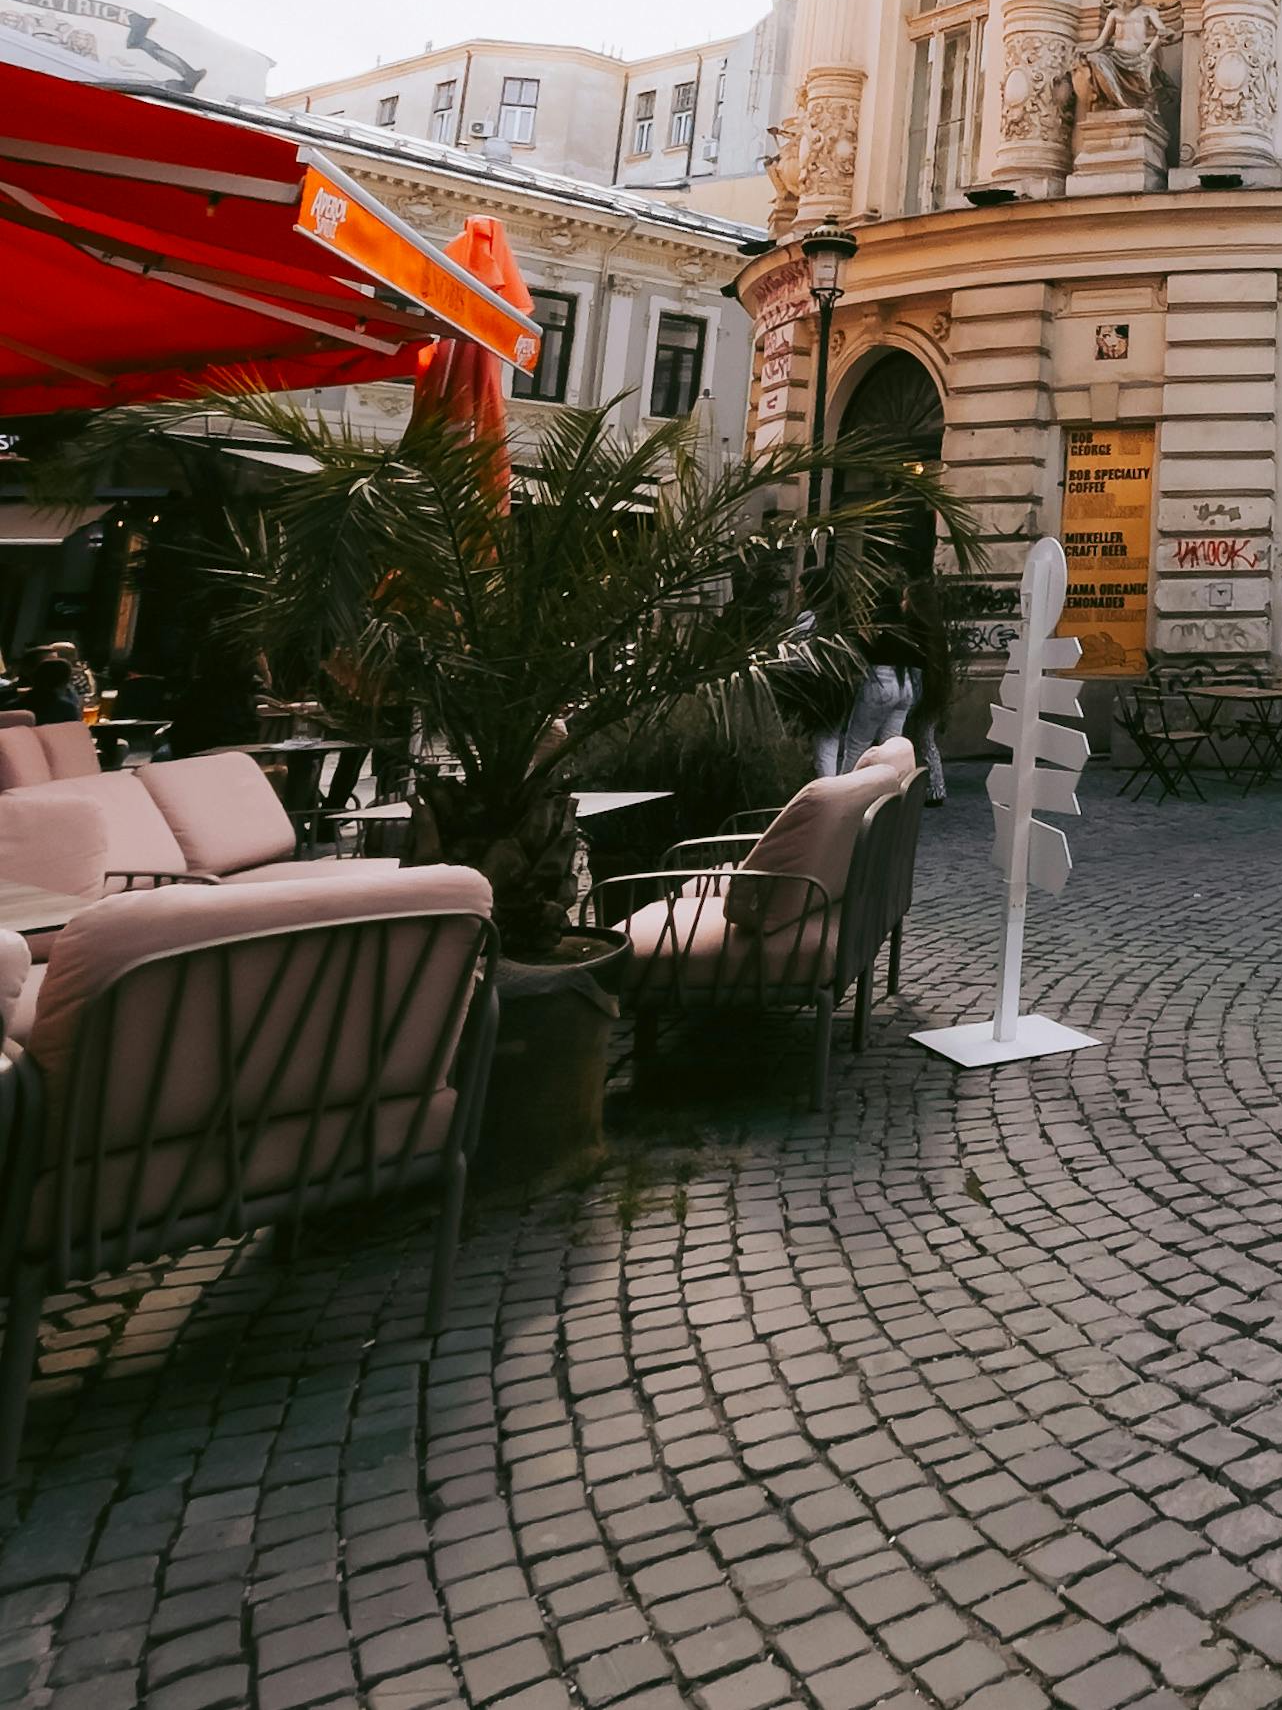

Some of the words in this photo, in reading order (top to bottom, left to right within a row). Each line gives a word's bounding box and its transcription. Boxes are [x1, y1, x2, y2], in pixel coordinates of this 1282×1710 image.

[1071, 432, 1093, 443] BOB
[1070, 444, 1111, 456] GEORGE
[1068, 470, 1091, 481] BOB
[1094, 468, 1150, 480] SPECIALTY
[1068, 482, 1105, 493] COFFEE
[1065, 532, 1123, 544] MIKKELLER
[1065, 545, 1098, 557] CRAFT
[1101, 545, 1127, 557] BEER
[1099, 583, 1148, 595] ORGANIC
